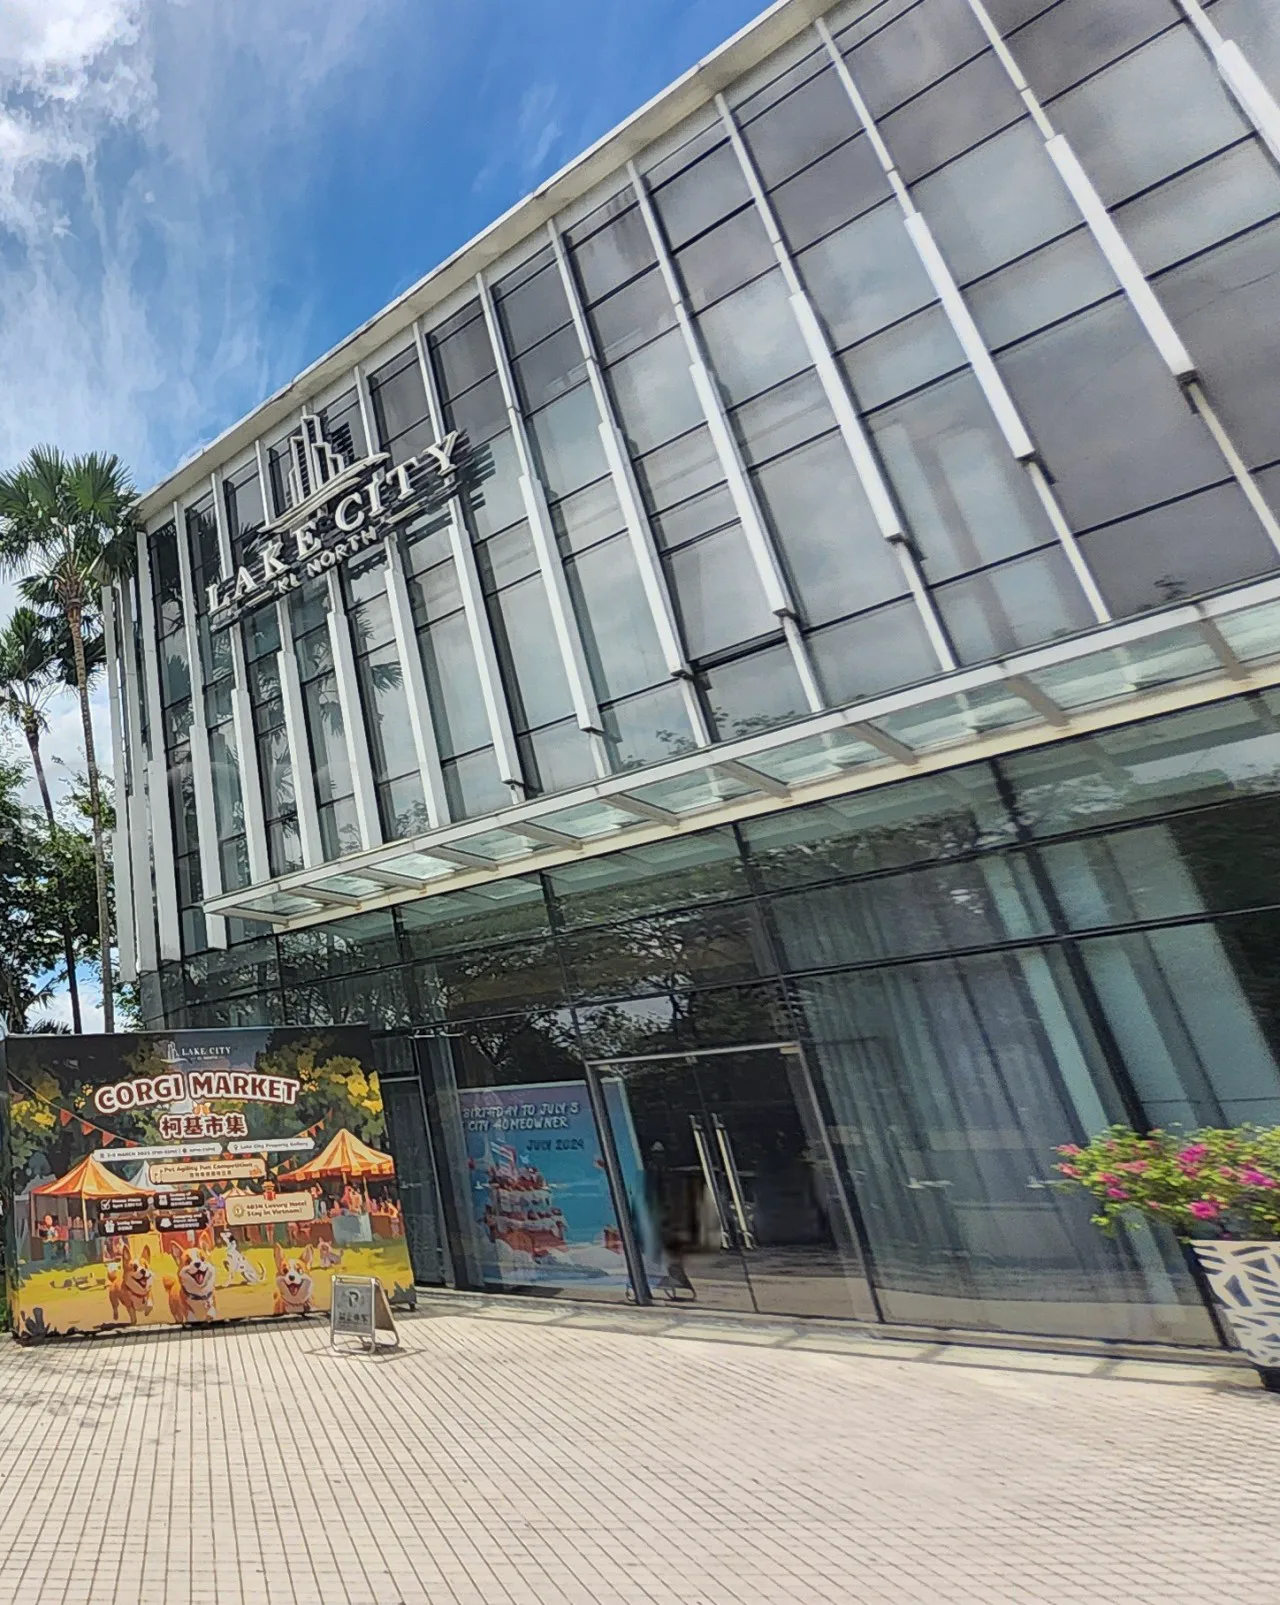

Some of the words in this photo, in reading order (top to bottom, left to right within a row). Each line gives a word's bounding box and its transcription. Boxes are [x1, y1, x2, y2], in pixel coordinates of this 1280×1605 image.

[205, 518, 319, 616] LAKE
[334, 430, 459, 532] CITY
[307, 524, 379, 578] NORTH
[181, 1047, 207, 1057] LAKE
[208, 1046, 231, 1055] CITY
[96, 1073, 184, 1112] CORGI
[189, 1072, 299, 1104] MARKET
[521, 1104, 536, 1115] TO
[540, 1102, 567, 1115] JULY
[160, 1113, 248, 1139] 柯基市集
[468, 1120, 489, 1131] CITY
[492, 1116, 569, 1130] HOMEOWNER
[526, 1139, 552, 1151] JULY
[176, 1164, 198, 1172] Agility
[213, 1161, 253, 1170] Competition
